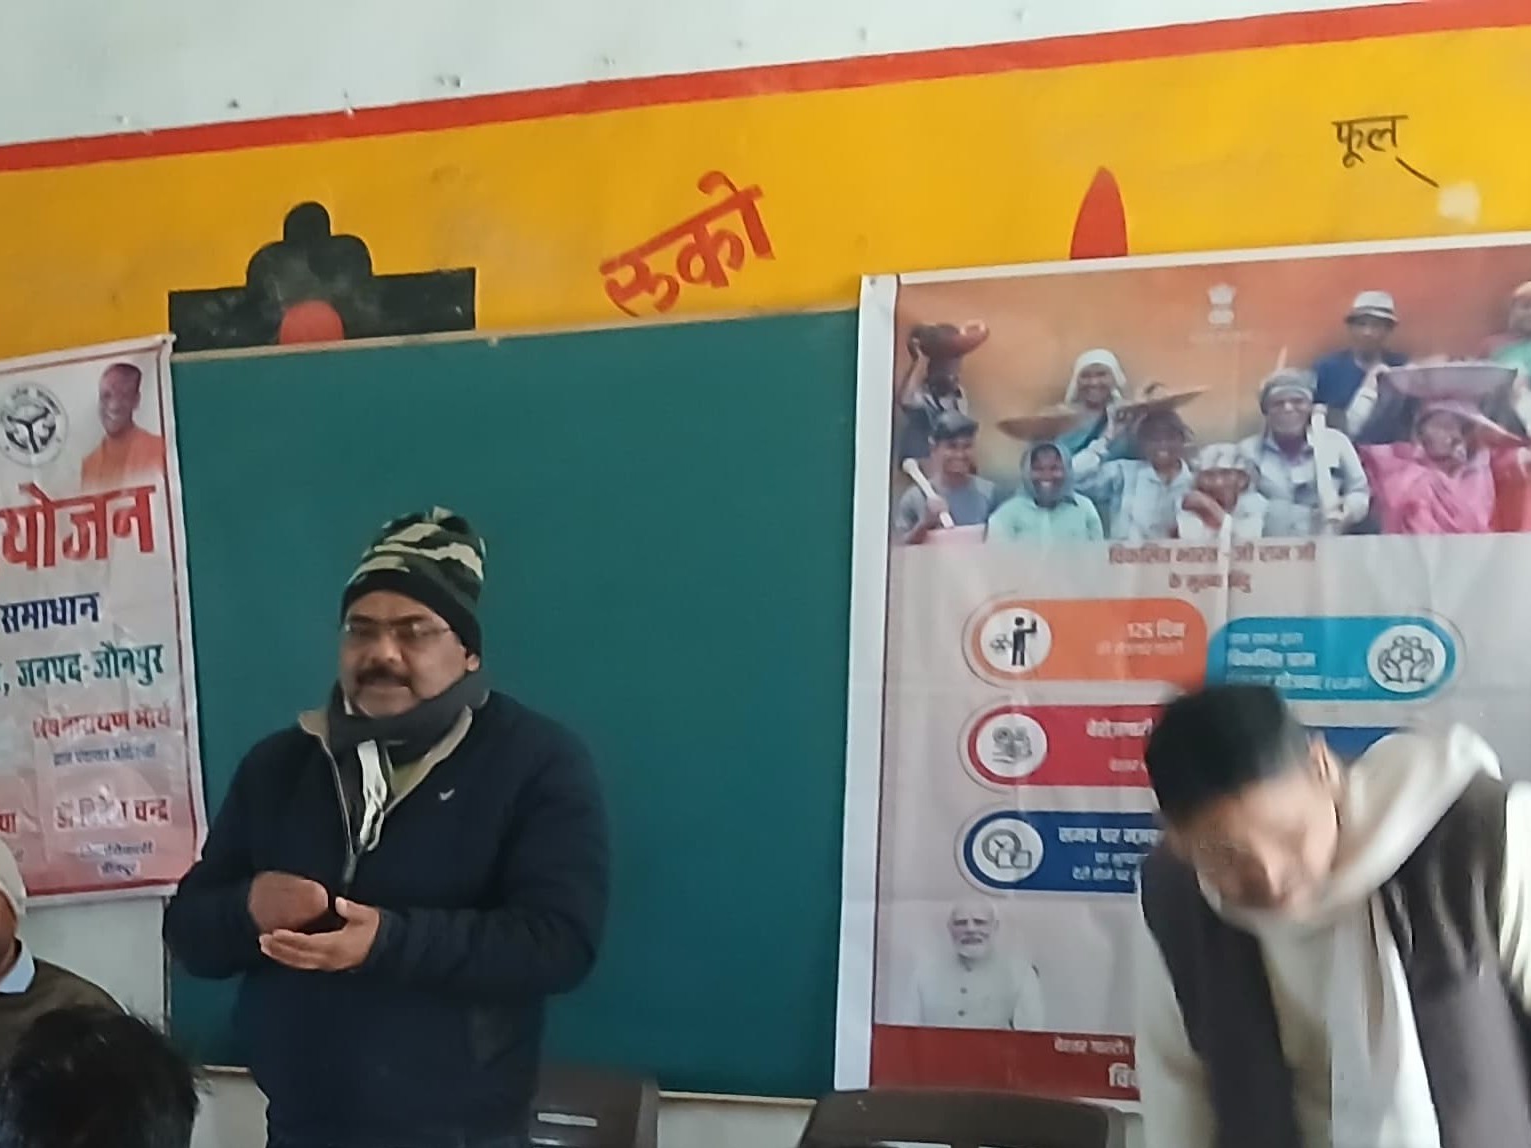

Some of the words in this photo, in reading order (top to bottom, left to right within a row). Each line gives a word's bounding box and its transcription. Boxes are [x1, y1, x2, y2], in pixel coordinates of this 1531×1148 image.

[1331, 114, 1409, 168] फूल
[599, 170, 776, 318] रुको
[0, 591, 100, 635] समाधान
